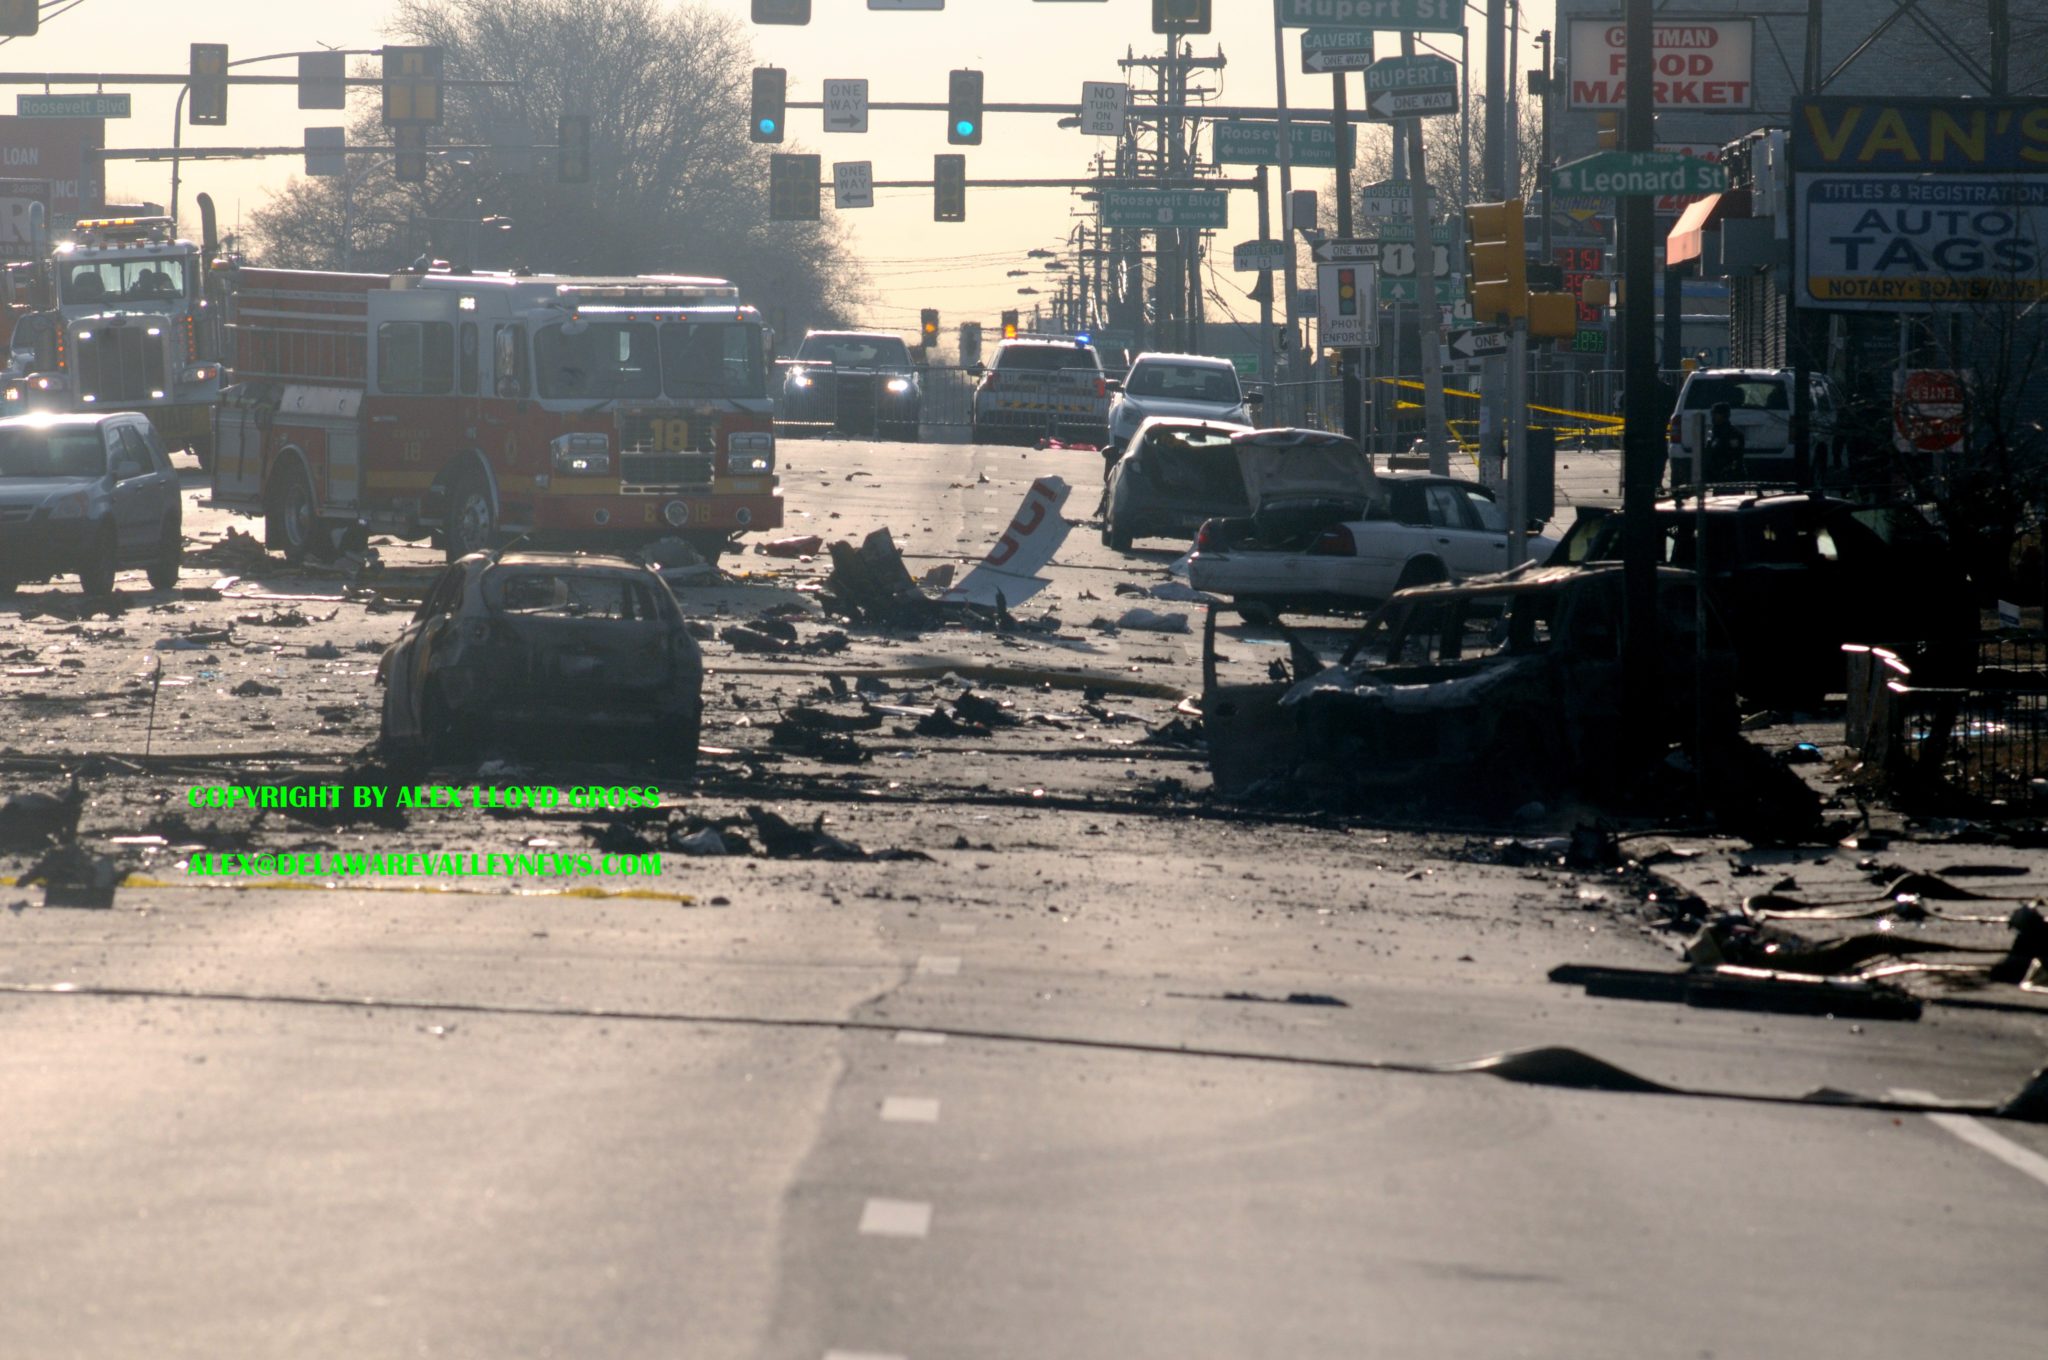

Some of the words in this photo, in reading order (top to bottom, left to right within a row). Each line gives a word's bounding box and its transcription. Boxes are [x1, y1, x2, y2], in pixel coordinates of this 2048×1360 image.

[1416, 0, 1449, 18] St
[1303, 32, 1361, 48] CALVERT
[1324, 55, 1343, 65] ONE
[1346, 54, 1367, 64] WAY
[1609, 54, 1714, 76] FOD
[1369, 65, 1439, 89] RUPERT
[830, 84, 861, 97] ONE
[1093, 87, 1115, 99] NO
[22, 100, 91, 114] Roosevelt
[96, 99, 126, 113] Blvd
[830, 99, 861, 111] WAY
[1089, 100, 1118, 111] TURN
[1394, 95, 1419, 109] ONE
[1423, 92, 1449, 106] WAY
[1095, 111, 1111, 121] ON
[1092, 121, 1114, 131] RED
[1804, 105, 2048, 164] VAN'S
[3, 147, 39, 165] LOAN
[840, 165, 867, 177] ONE
[1580, 165, 1686, 192] Leonard
[1697, 167, 1722, 189] St
[840, 179, 867, 190] WAY
[1824, 183, 1884, 198] TITLES
[1890, 184, 1902, 198] &
[1110, 194, 1182, 207] Roosevelt
[1188, 195, 1221, 207] Blvd
[1852, 208, 2014, 236] AUTO
[1332, 246, 1352, 257] ONE
[1355, 245, 1375, 255] WAY
[1829, 236, 2036, 273] TAGS
[1393, 248, 1402, 270] 1
[1828, 280, 1907, 297] NOTARY
[1475, 334, 1500, 348] ONE
[650, 419, 688, 451] 18
